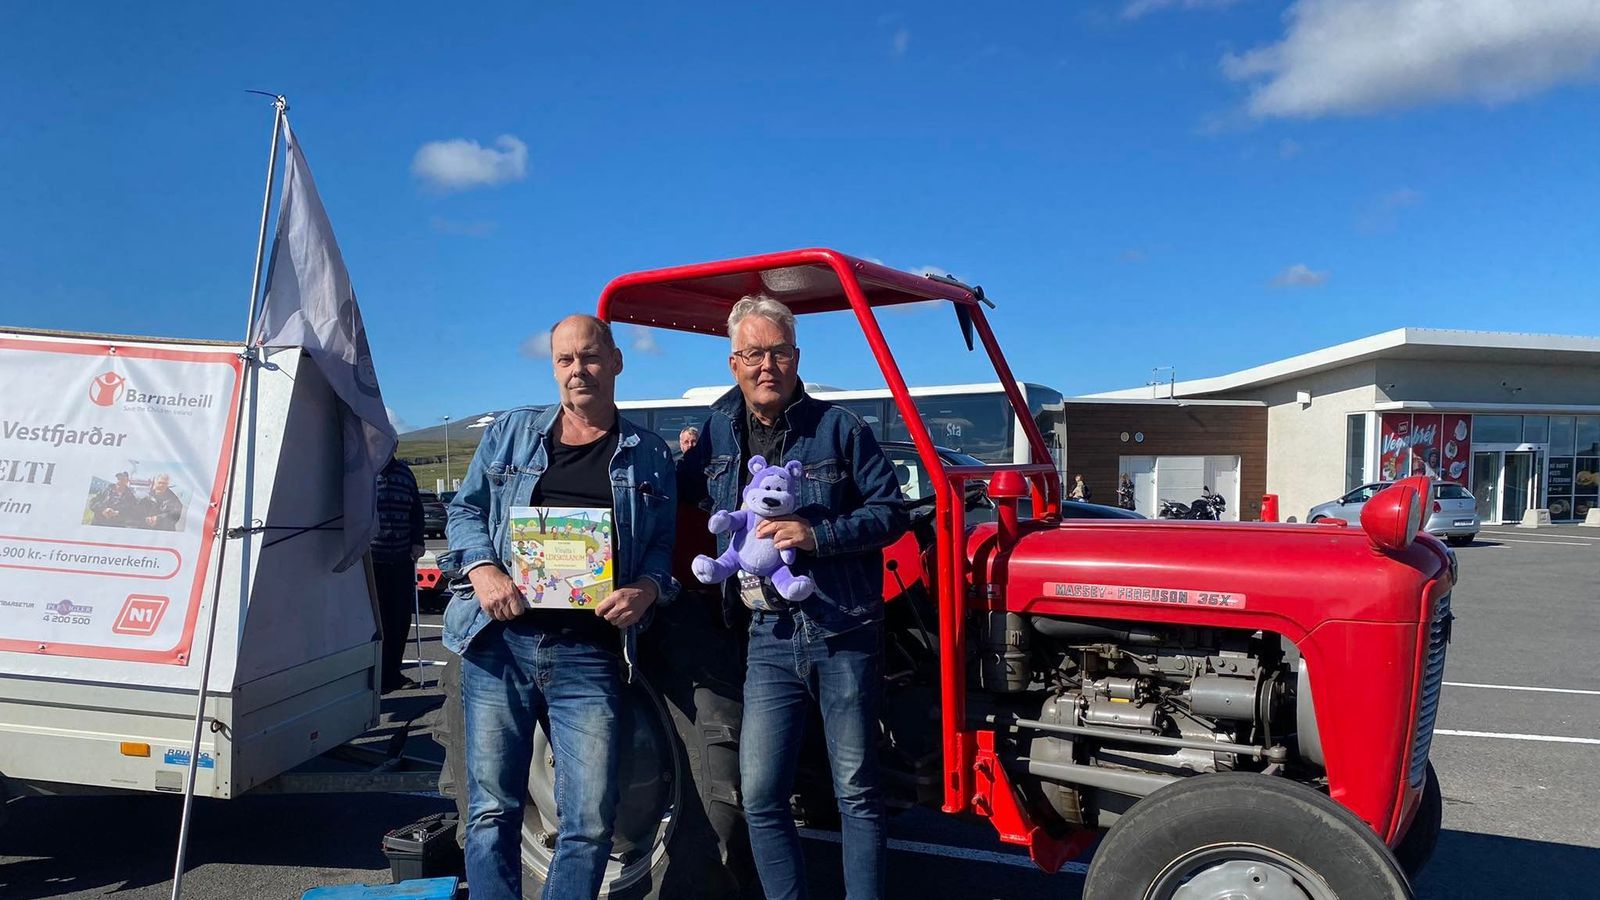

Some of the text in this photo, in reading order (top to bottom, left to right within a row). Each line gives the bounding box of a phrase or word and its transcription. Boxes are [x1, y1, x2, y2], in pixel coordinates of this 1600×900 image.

[125, 388, 213, 409] Barnaheill
[3, 420, 127, 447] Vestfjarðar
[56, 549, 160, 569] forvarnaverkefni.
[43, 614, 91, 625] 4 200 500
[129, 607, 153, 623] N1
